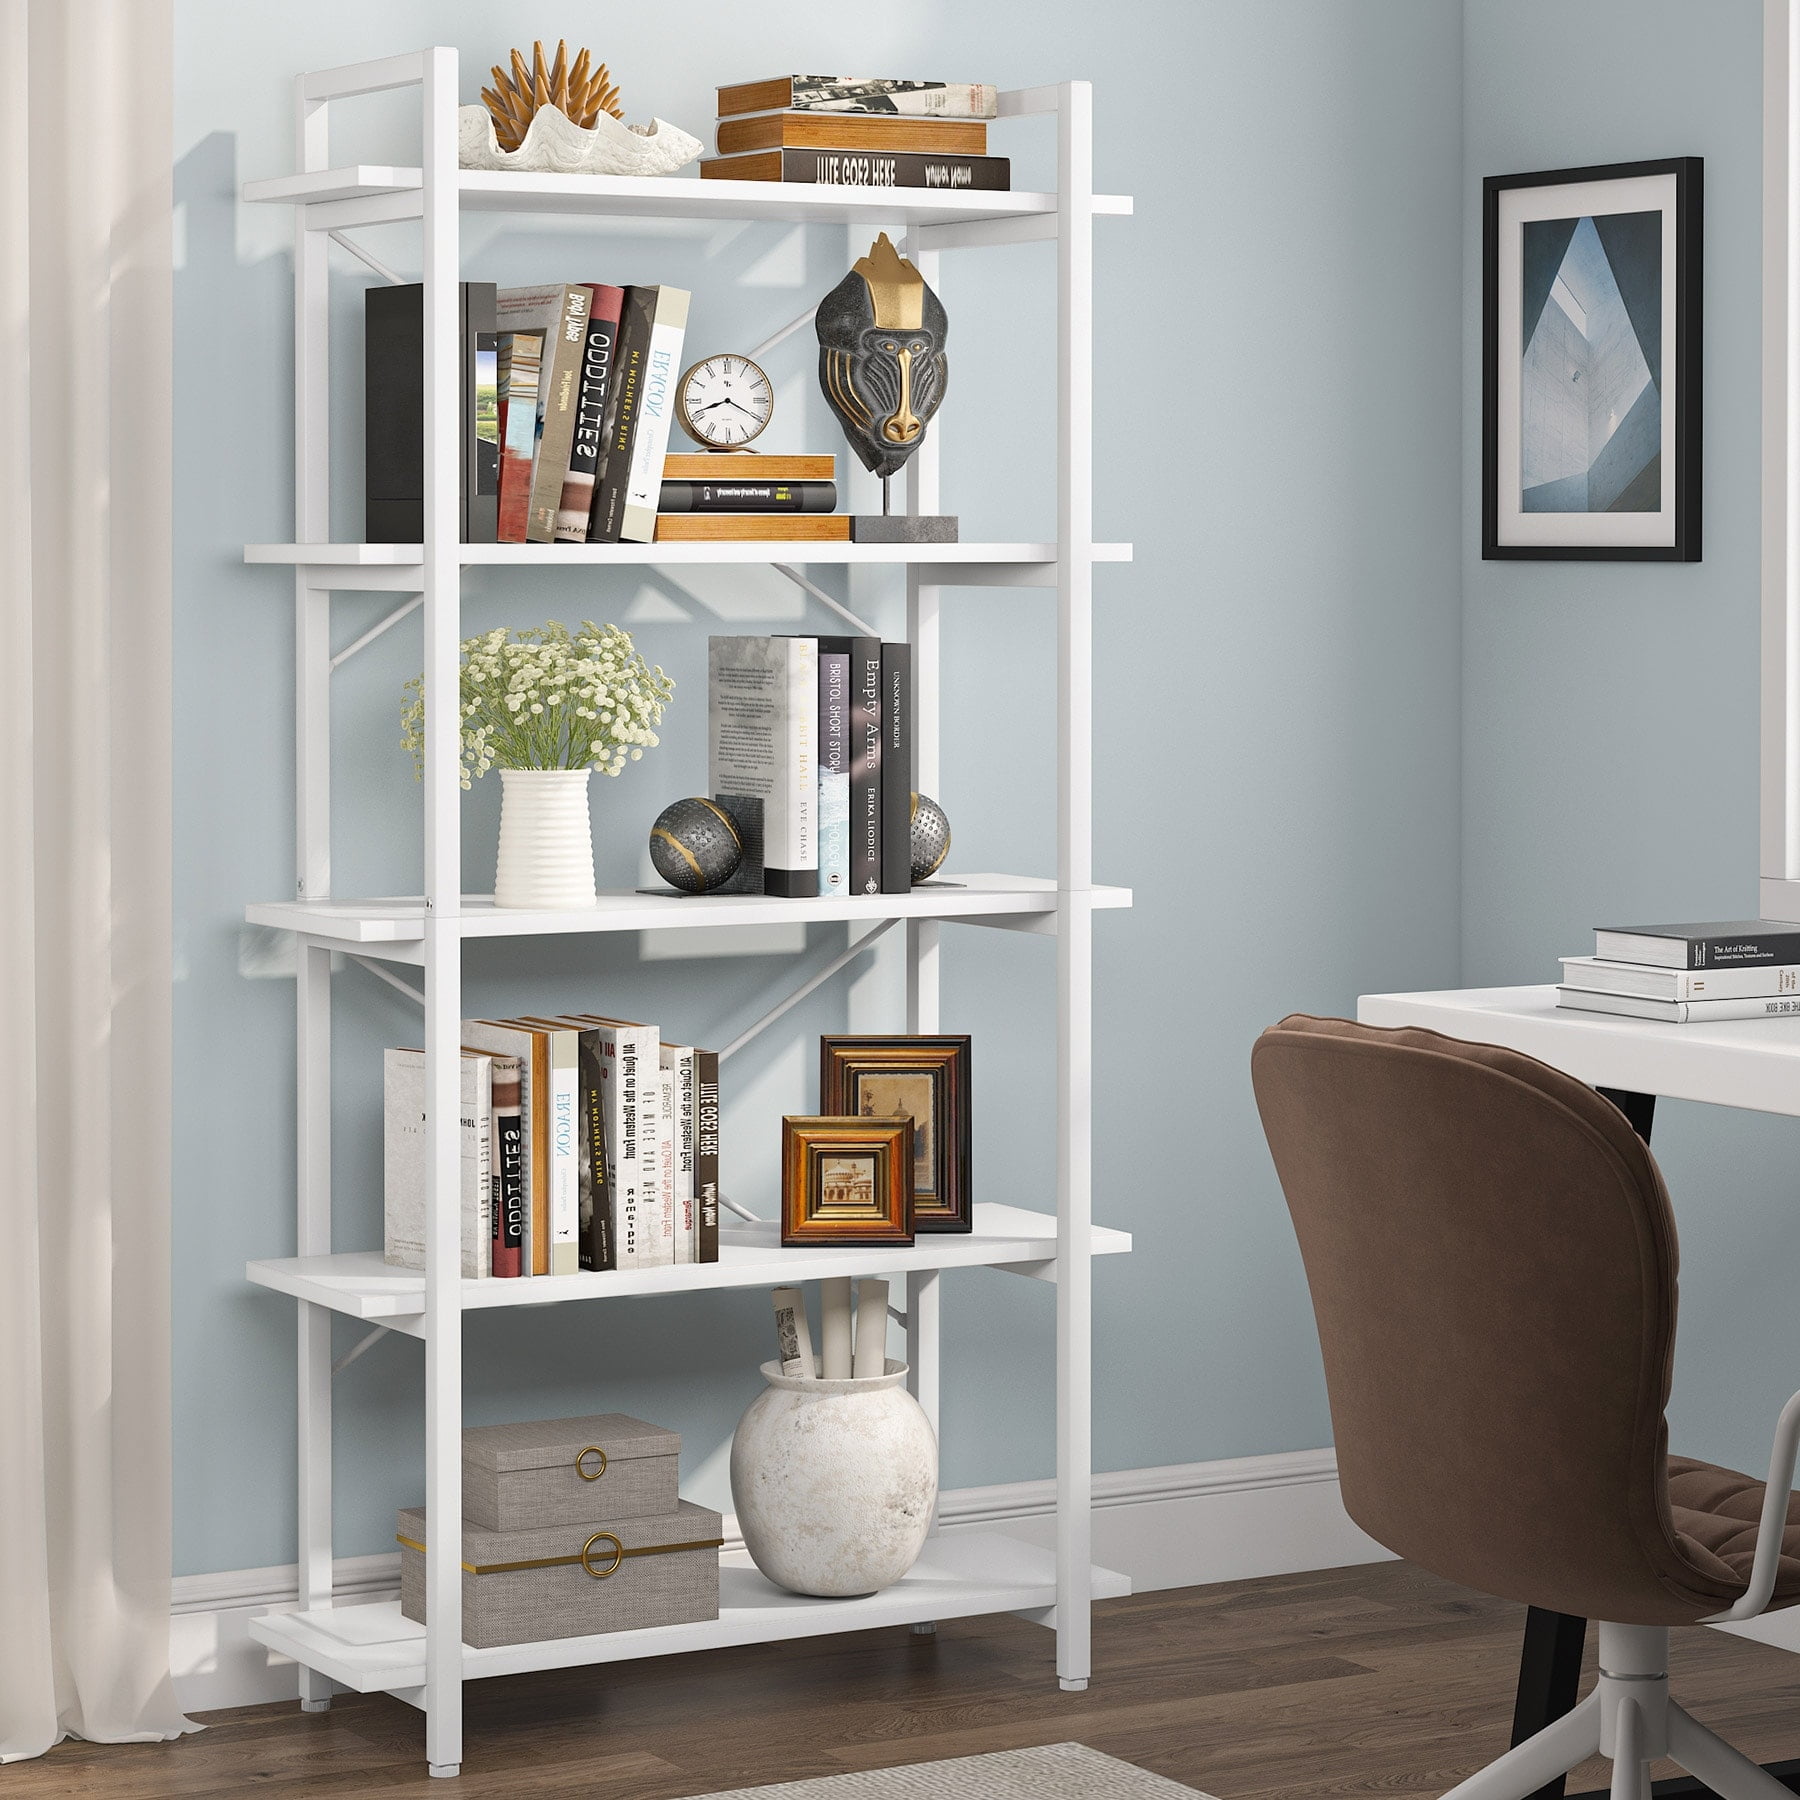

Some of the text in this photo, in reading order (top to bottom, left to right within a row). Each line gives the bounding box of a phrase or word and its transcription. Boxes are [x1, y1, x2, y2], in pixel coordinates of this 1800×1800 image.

[829, 663, 841, 702] BRISTOL
[829, 705, 841, 737] SHORT
[862, 660, 879, 769] Empty Arms
[800, 754, 808, 791] HALL
[829, 741, 841, 773] STORY
[800, 802, 808, 862] EVE CHASE
[1739, 945, 1758, 953] Knitting
